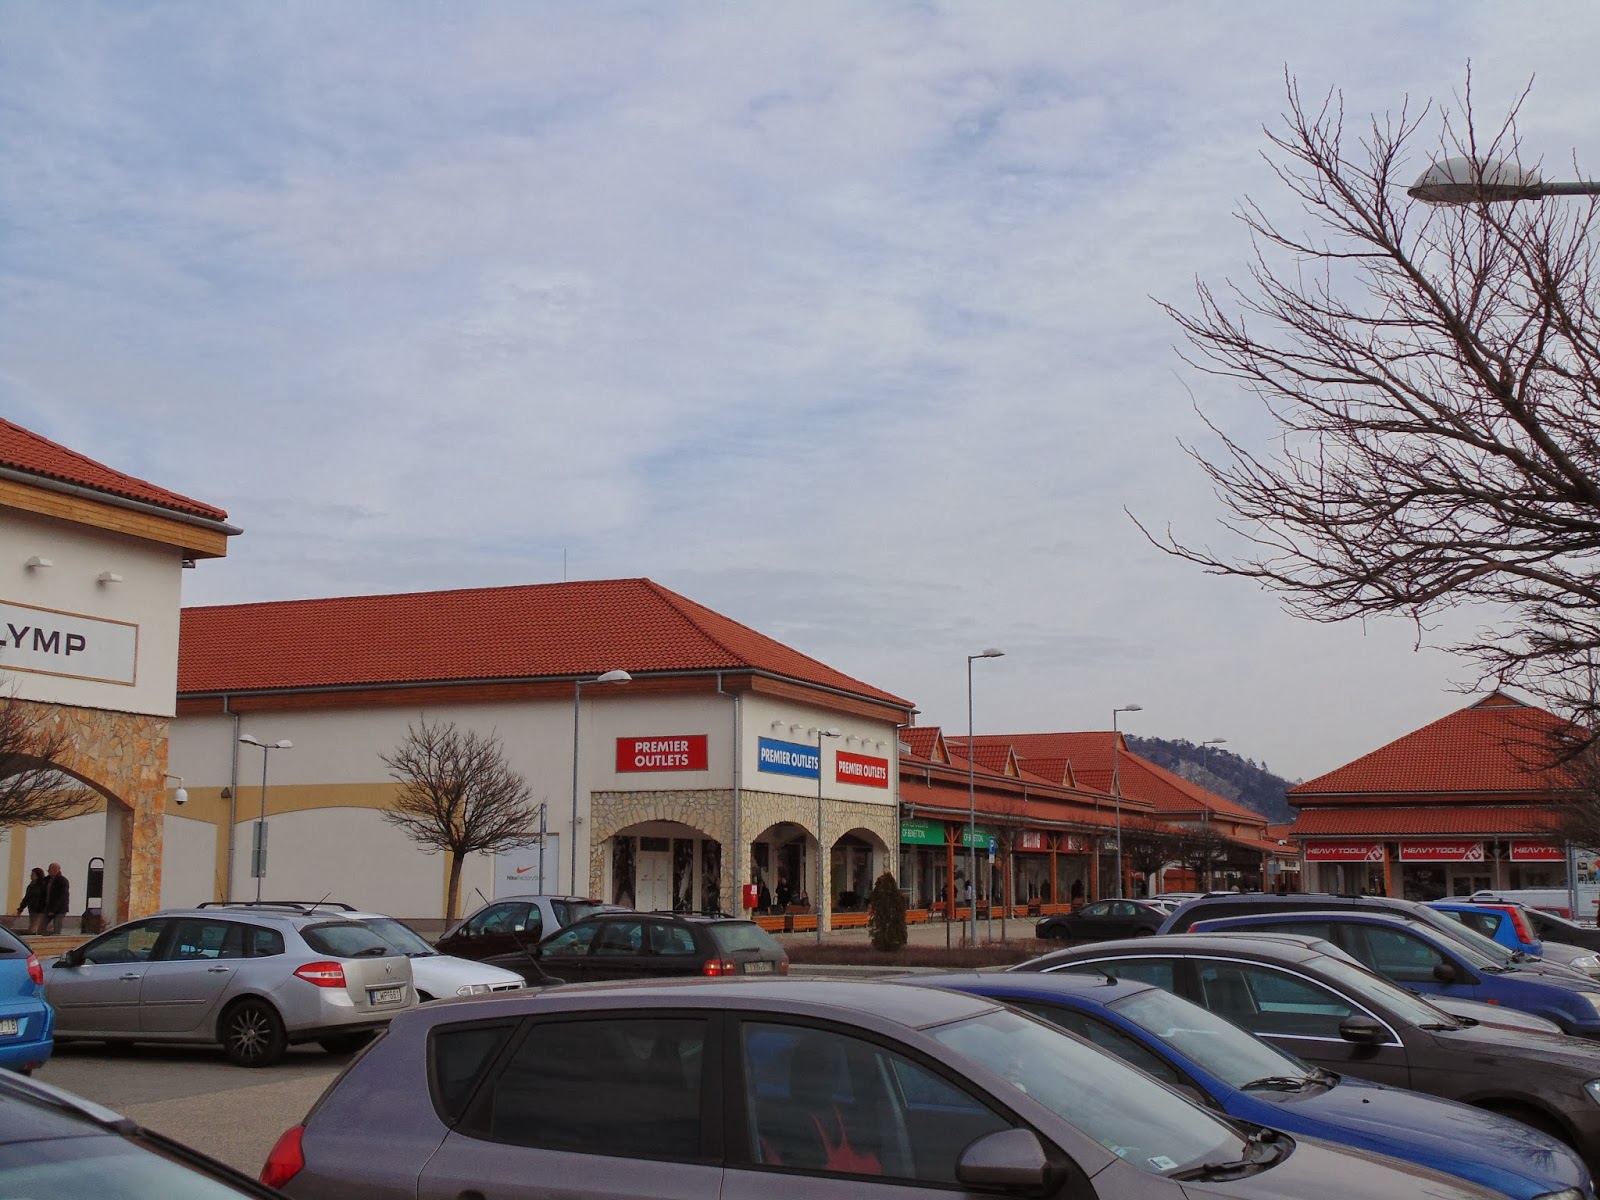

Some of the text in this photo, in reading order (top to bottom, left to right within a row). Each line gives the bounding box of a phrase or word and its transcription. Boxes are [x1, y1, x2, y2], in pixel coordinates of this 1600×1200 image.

[635, 741, 689, 753] PREMIER
[634, 754, 689, 767] OUTLETS
[761, 747, 819, 770] PREMIER OUTLETS
[838, 760, 887, 780] PREMIER OUTLETS
